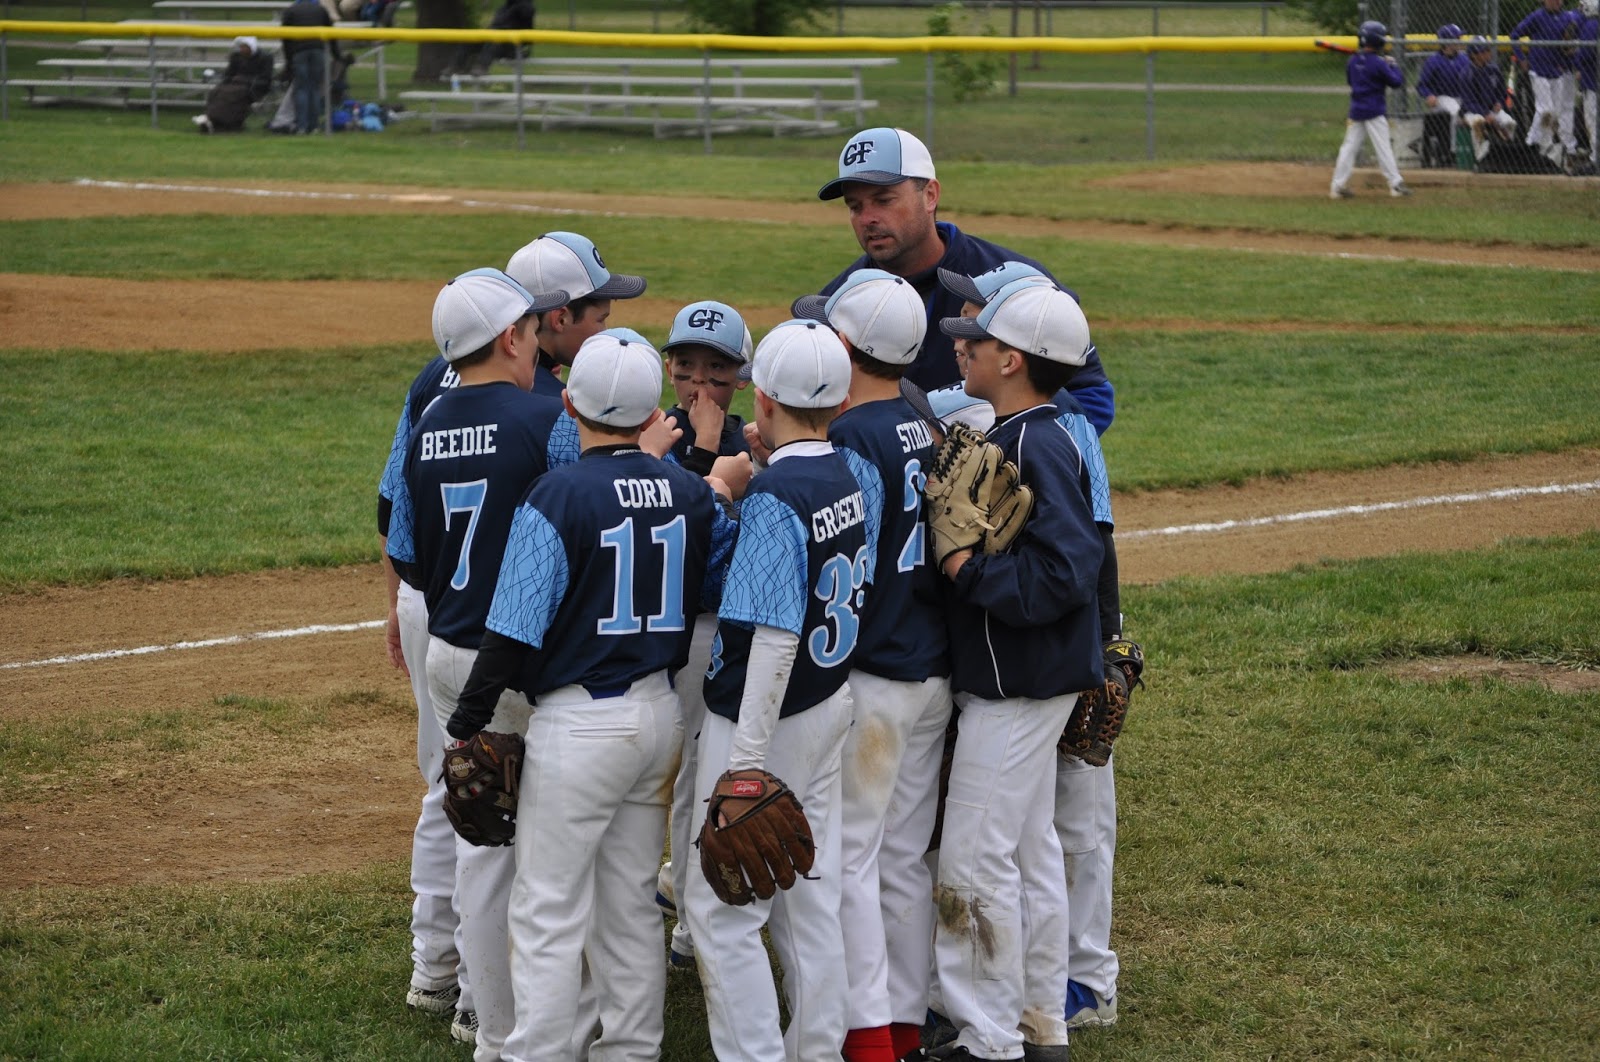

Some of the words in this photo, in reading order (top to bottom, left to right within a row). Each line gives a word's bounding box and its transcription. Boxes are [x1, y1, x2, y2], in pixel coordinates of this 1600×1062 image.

[843, 141, 874, 166] GF
[688, 309, 724, 332] GF
[421, 424, 498, 461] BEEDIE
[613, 479, 673, 508] CORN
[440, 478, 488, 591] 7
[597, 515, 687, 635] 11
